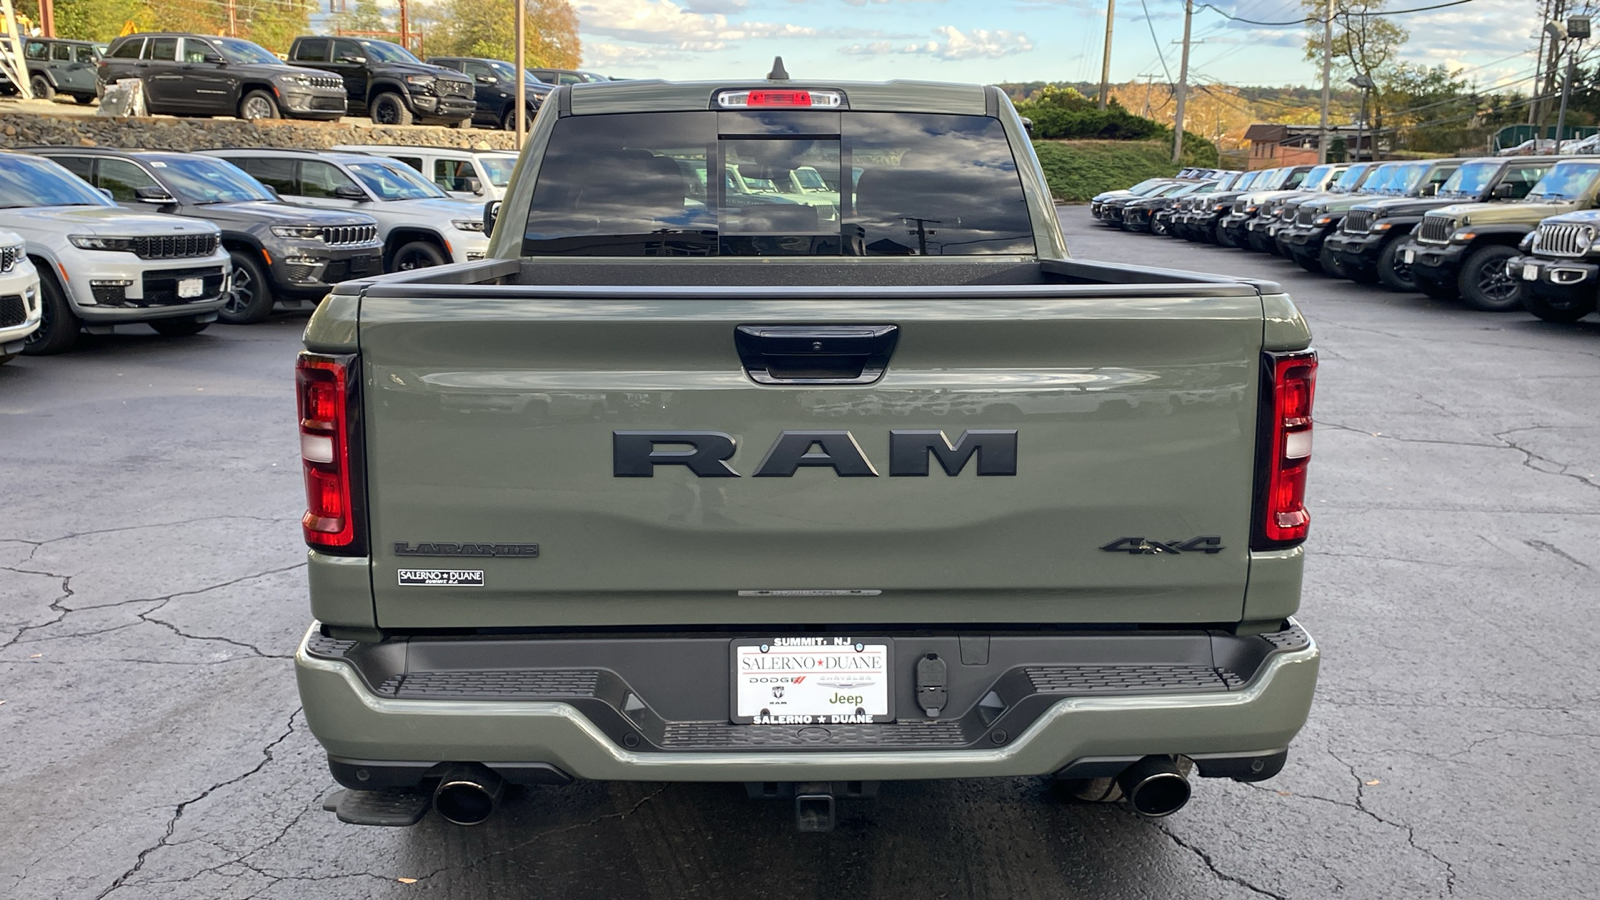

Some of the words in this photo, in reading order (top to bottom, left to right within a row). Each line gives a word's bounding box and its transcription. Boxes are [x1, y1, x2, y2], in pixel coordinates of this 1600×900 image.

[613, 429, 1018, 477] RAM
[394, 542, 539, 557] LARAMIE
[400, 571, 441, 580] SALERNO
[450, 571, 482, 580] DUANE
[834, 637, 851, 646] NJ
[742, 656, 816, 670] SALERNO
[825, 656, 882, 670] DUANE
[829, 692, 863, 706] Jeep
[753, 714, 813, 725] SALERNO
[831, 714, 874, 724] DUANE
